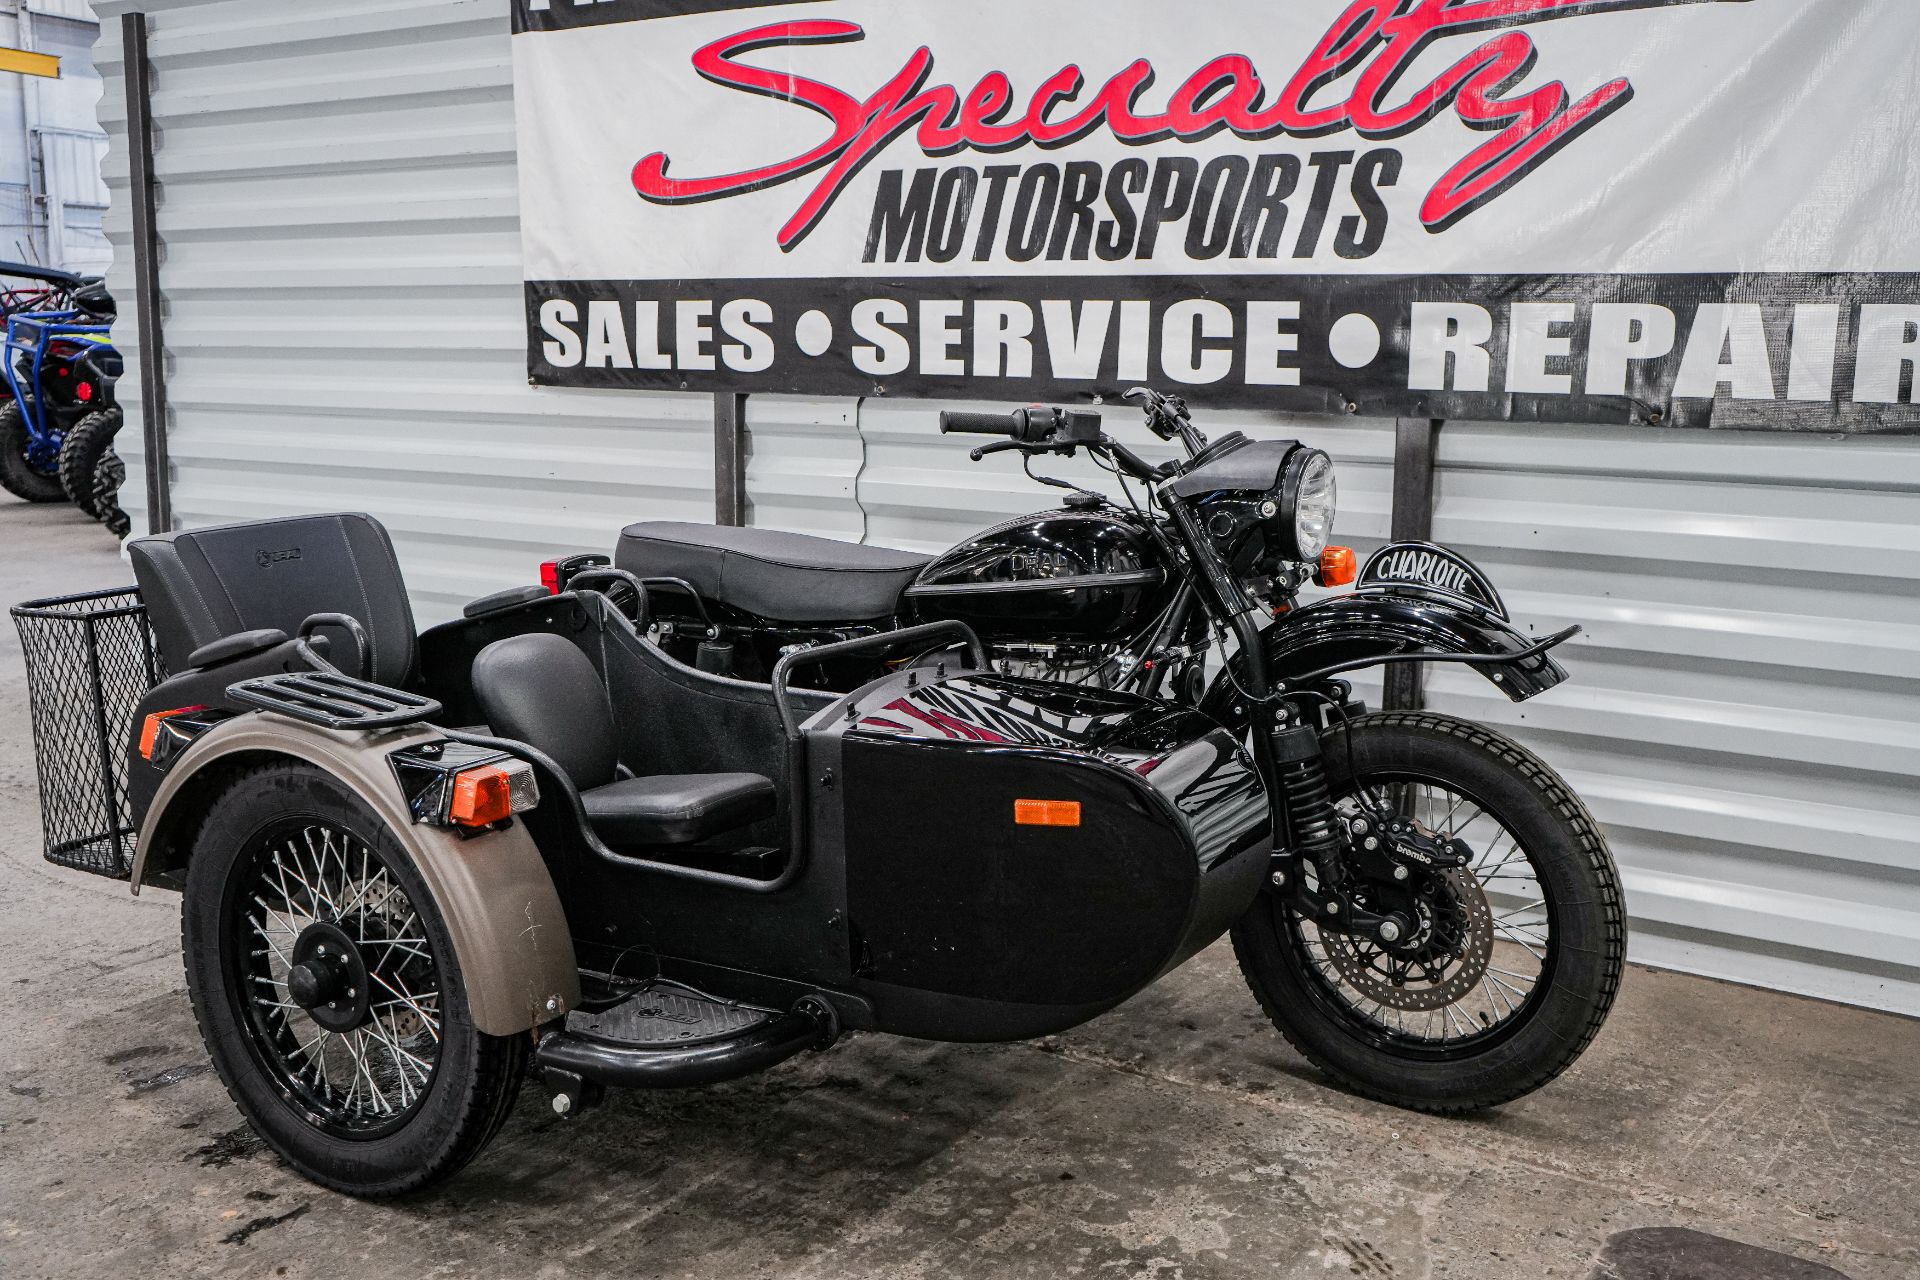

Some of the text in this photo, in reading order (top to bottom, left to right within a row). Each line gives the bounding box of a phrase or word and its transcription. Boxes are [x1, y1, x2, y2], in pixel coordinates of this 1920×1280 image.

[631, 0, 1760, 253] Specialty
[862, 148, 1402, 263] MOTORSPORTS
[540, 298, 1920, 404] SALES SERVICE REPAIR
[1377, 550, 1472, 593] CHARLOTTE
[1396, 844, 1432, 864] brembo
